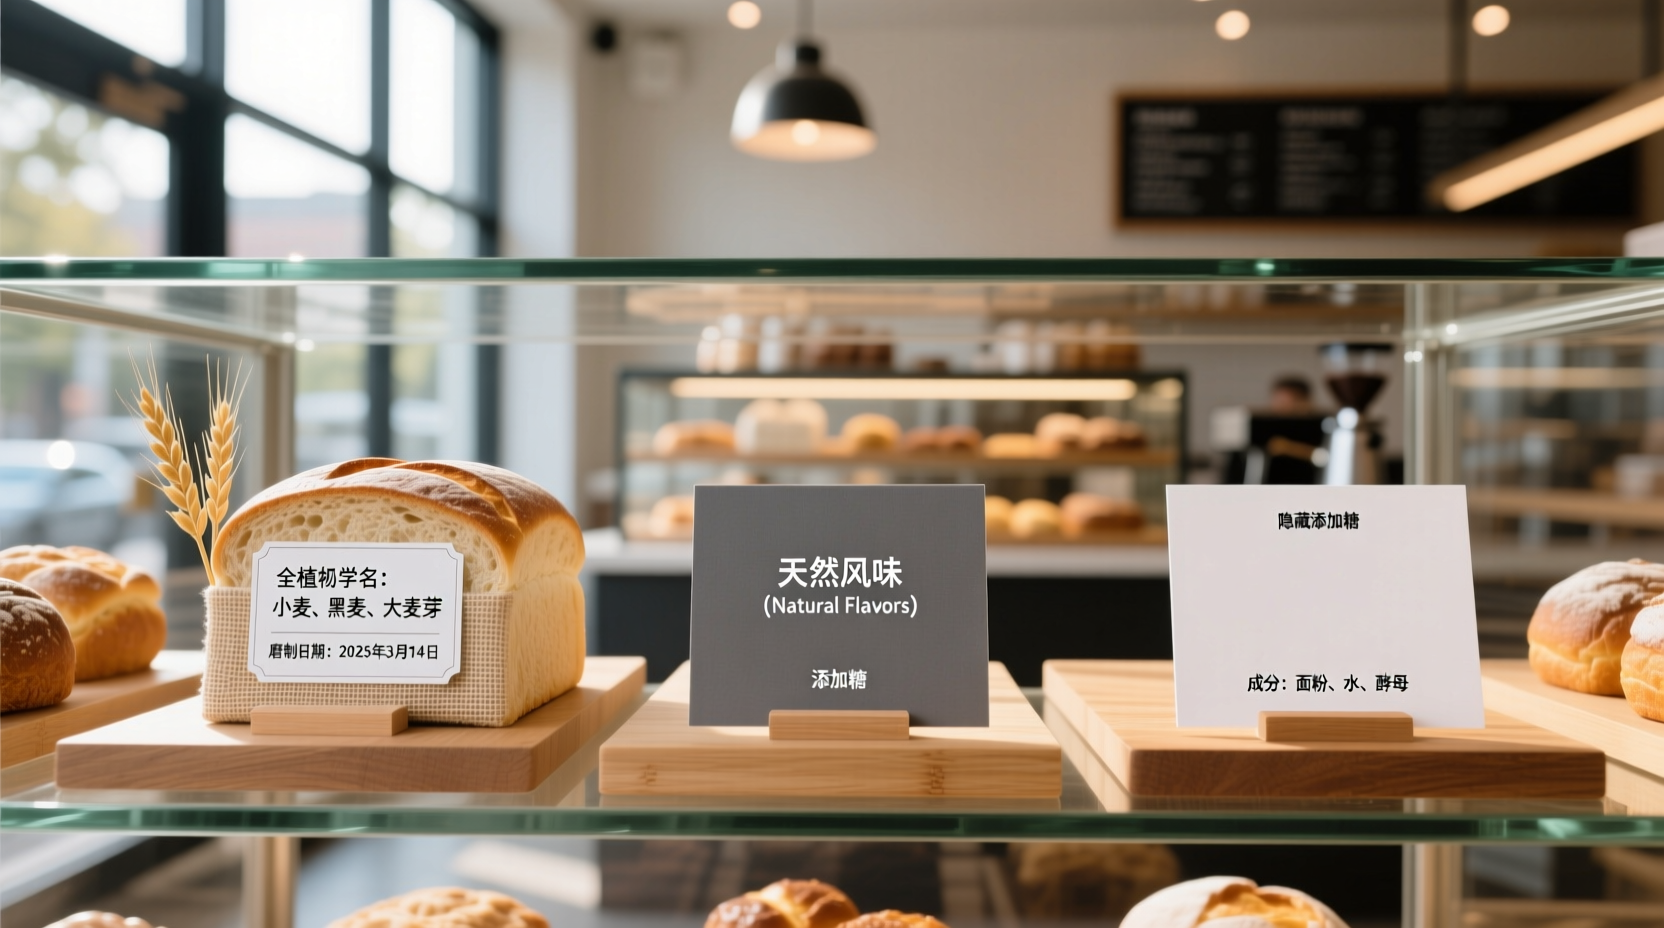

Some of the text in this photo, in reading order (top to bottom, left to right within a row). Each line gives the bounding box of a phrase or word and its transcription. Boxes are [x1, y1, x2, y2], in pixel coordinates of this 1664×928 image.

[777, 555, 903, 589] 天然风味
[763, 594, 918, 619] (Natural Flavors)
[811, 668, 868, 690] 添加糖
